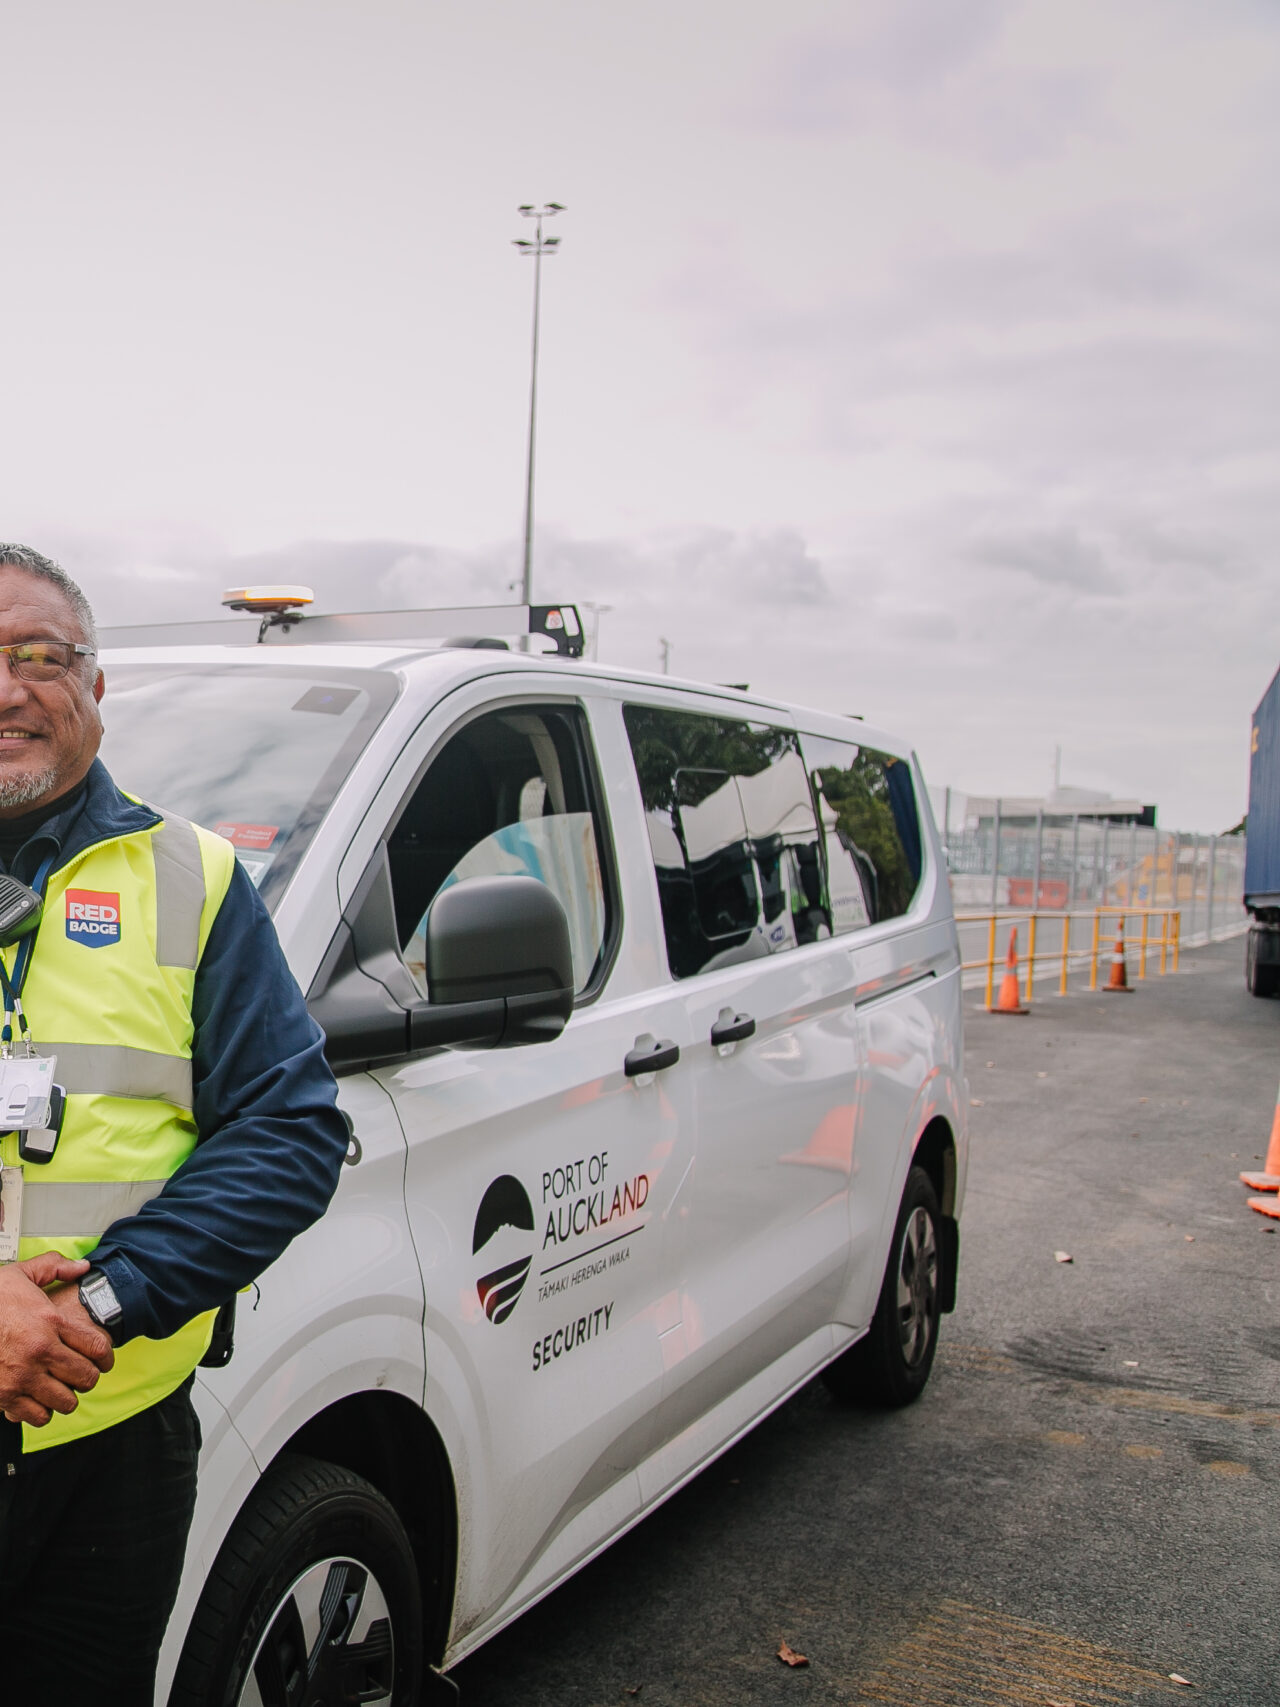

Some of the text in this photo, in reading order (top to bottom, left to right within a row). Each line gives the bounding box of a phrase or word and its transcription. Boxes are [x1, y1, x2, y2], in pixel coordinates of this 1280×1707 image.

[69, 902, 118, 922] RED
[69, 921, 118, 935] BADGE
[542, 1151, 609, 1203] PORT OF
[542, 1174, 649, 1250] AUCKLAND
[538, 1248, 630, 1302] TĀMAKI HERENGA WAKA
[532, 1301, 615, 1372] SECURITY
